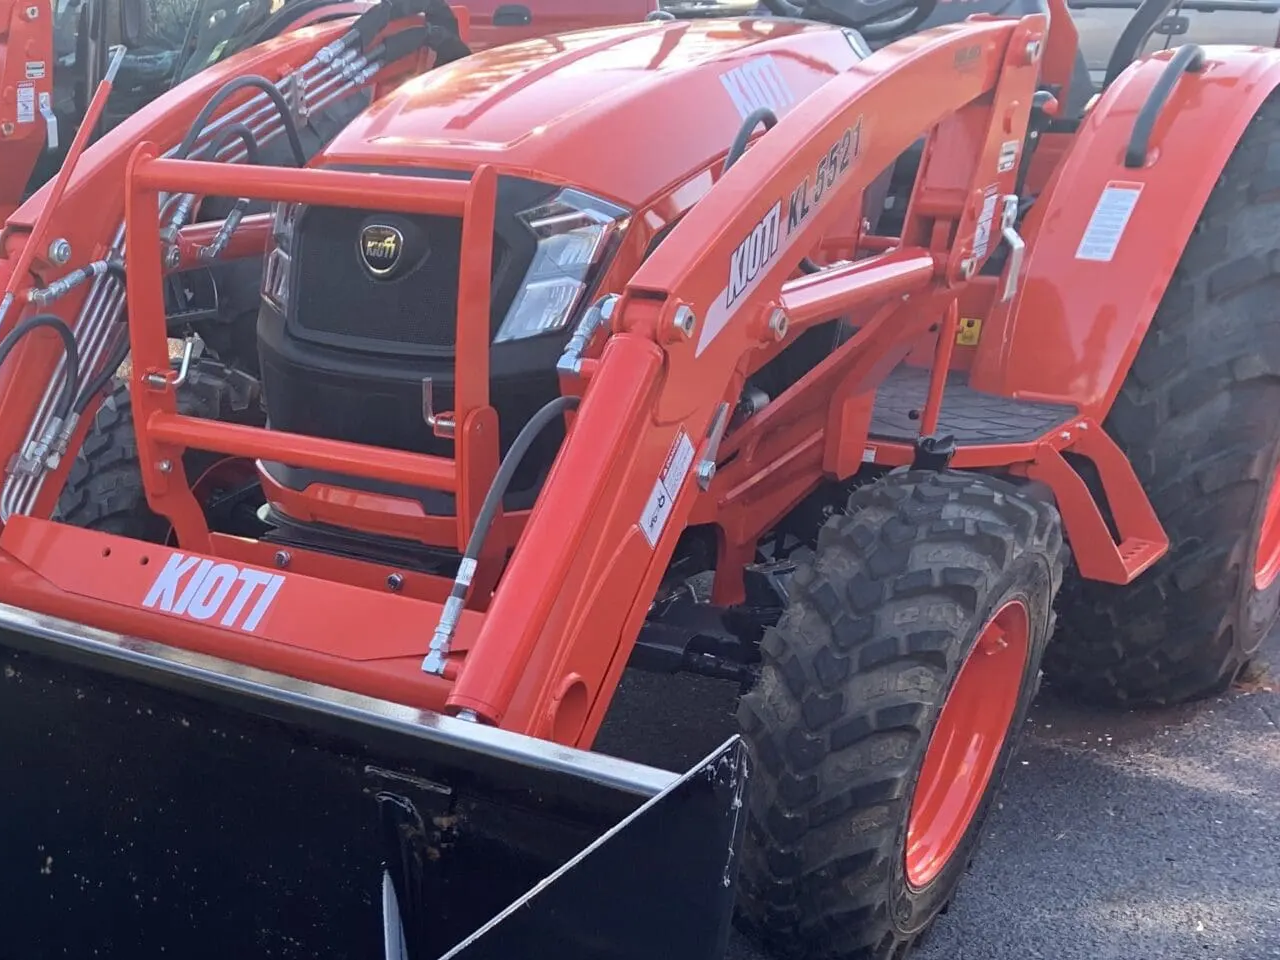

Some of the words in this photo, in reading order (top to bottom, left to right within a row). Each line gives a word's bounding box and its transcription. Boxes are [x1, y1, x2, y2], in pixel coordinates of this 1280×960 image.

[366, 240, 396, 259] KIOTI
[726, 200, 782, 309] KIOTI
[142, 552, 286, 632] KIOTI
